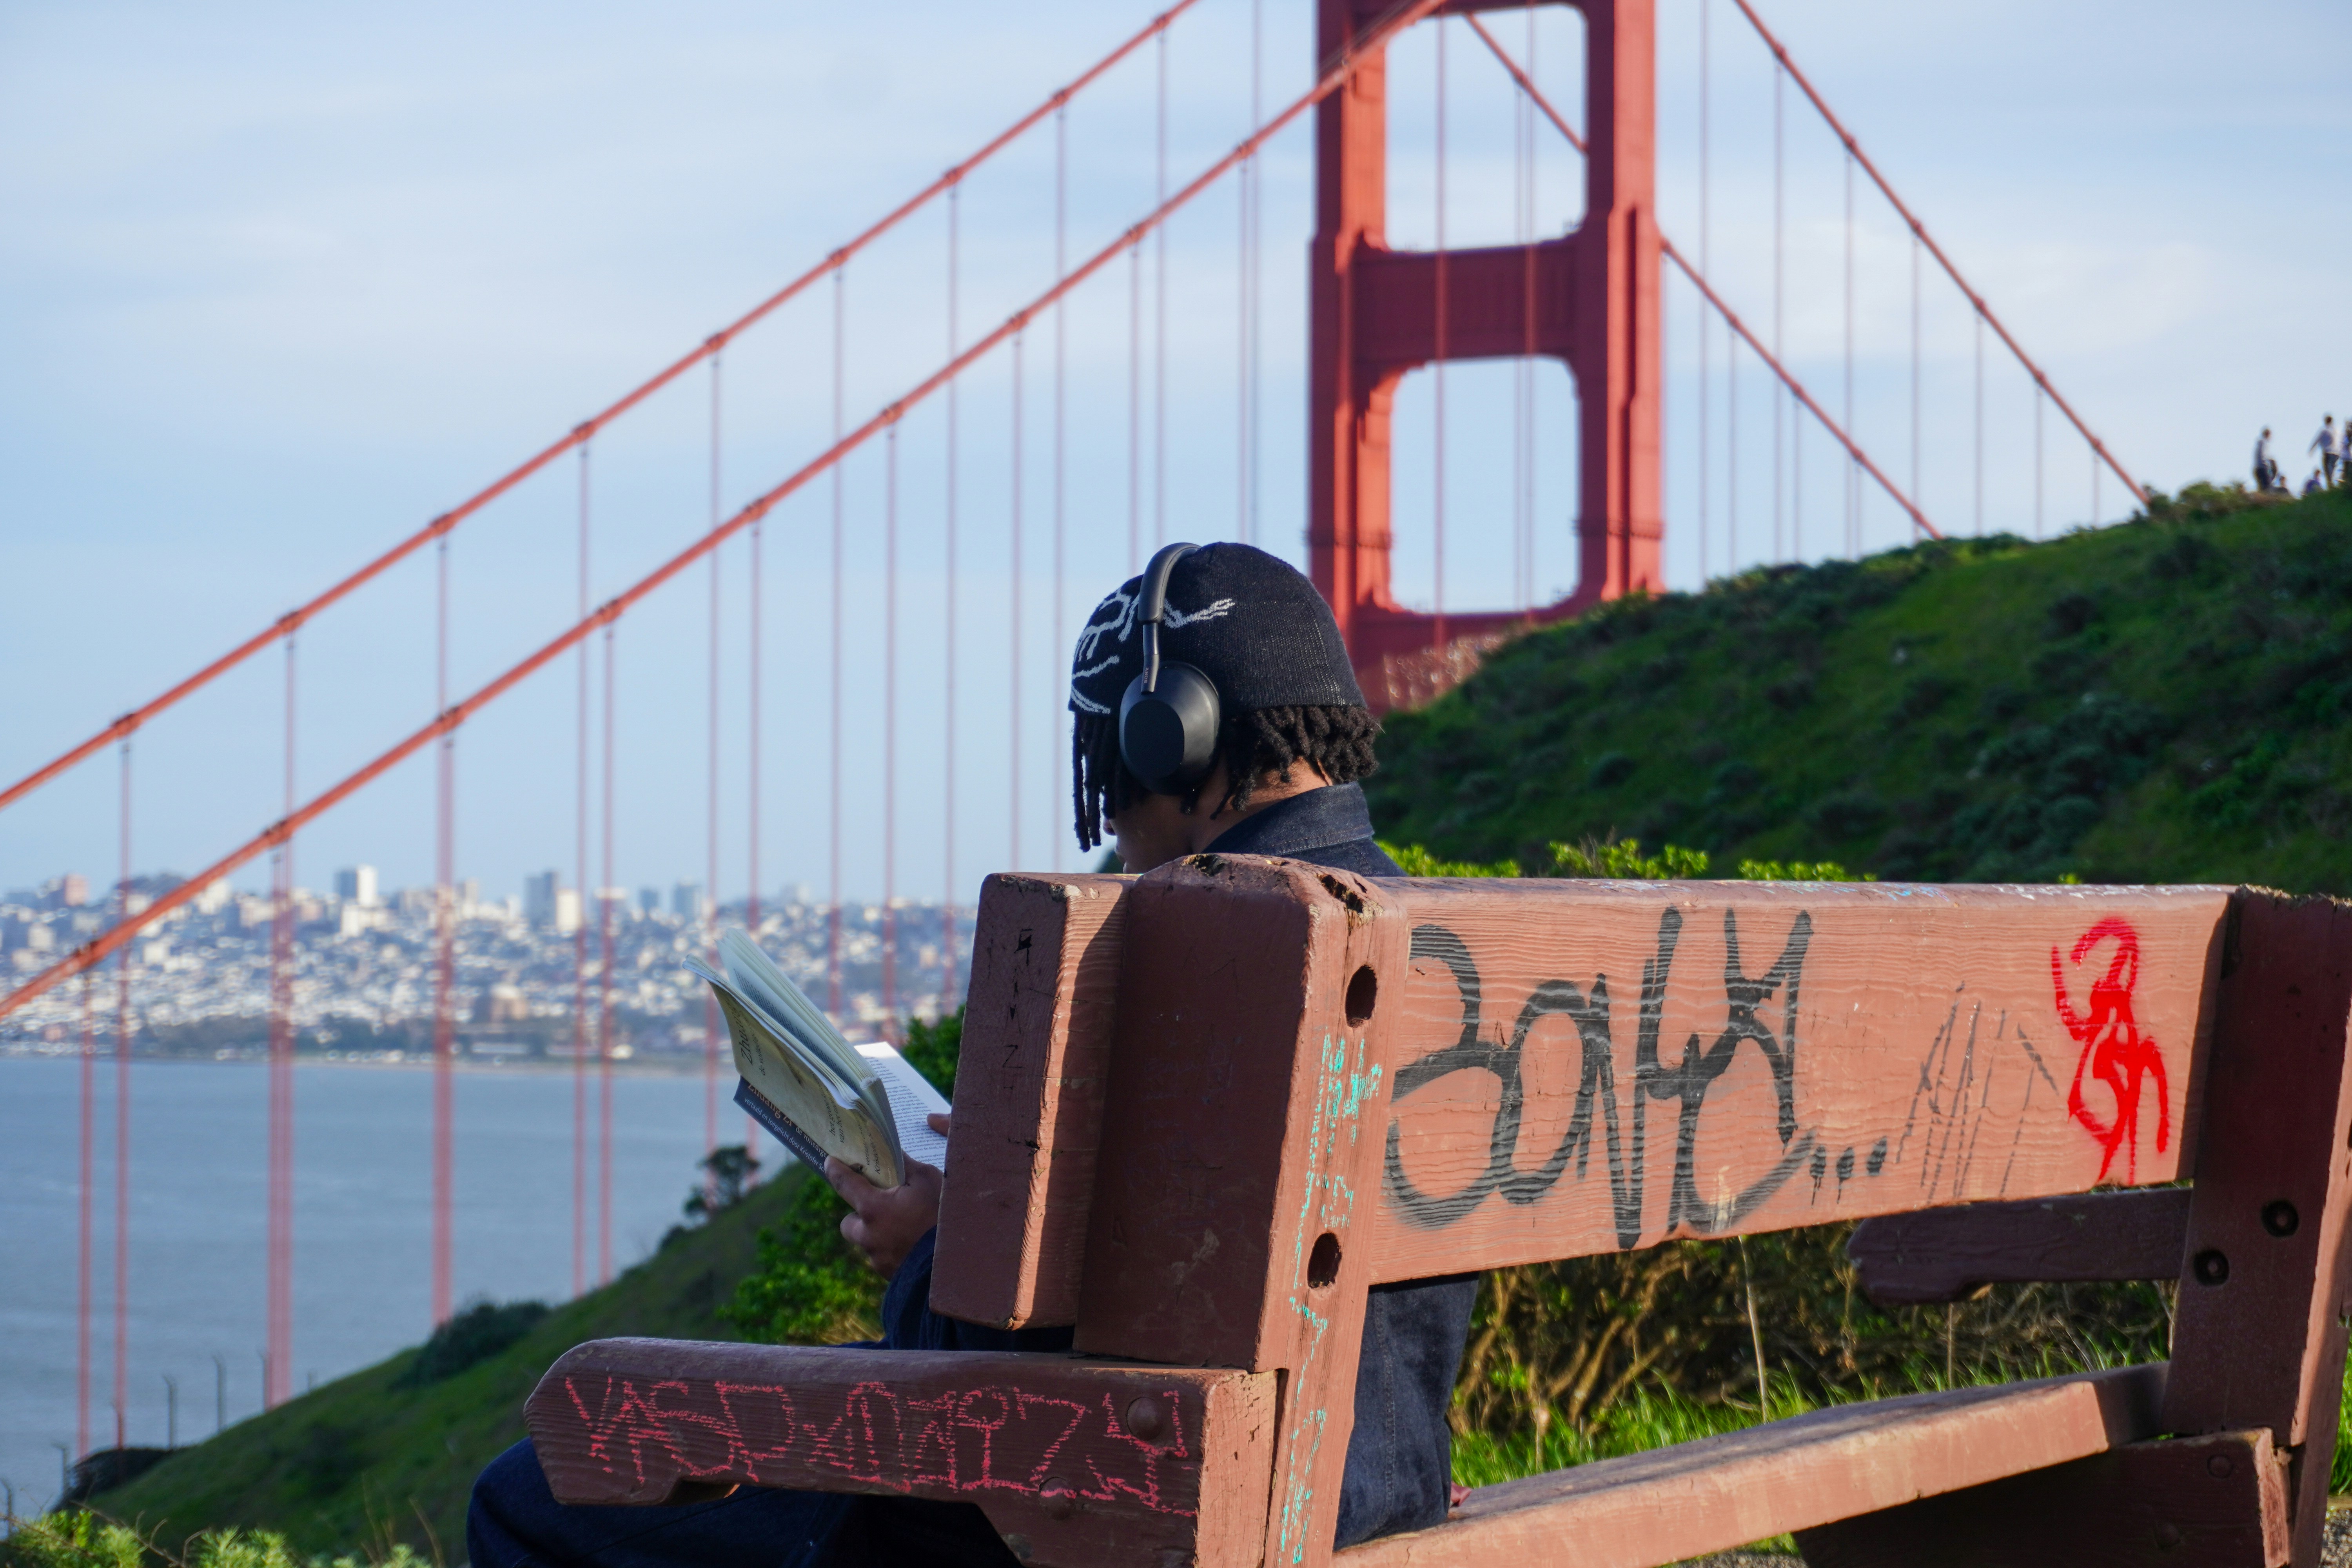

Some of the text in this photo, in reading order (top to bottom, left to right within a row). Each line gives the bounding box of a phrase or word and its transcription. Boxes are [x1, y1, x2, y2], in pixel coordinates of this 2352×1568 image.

[744, 1098, 762, 1116] vertaald
[768, 1117, 789, 1140] toegelicht
[789, 1137, 800, 1149] door
[799, 1146, 819, 1166] Kristofer
[796, 1126, 802, 1136] de
